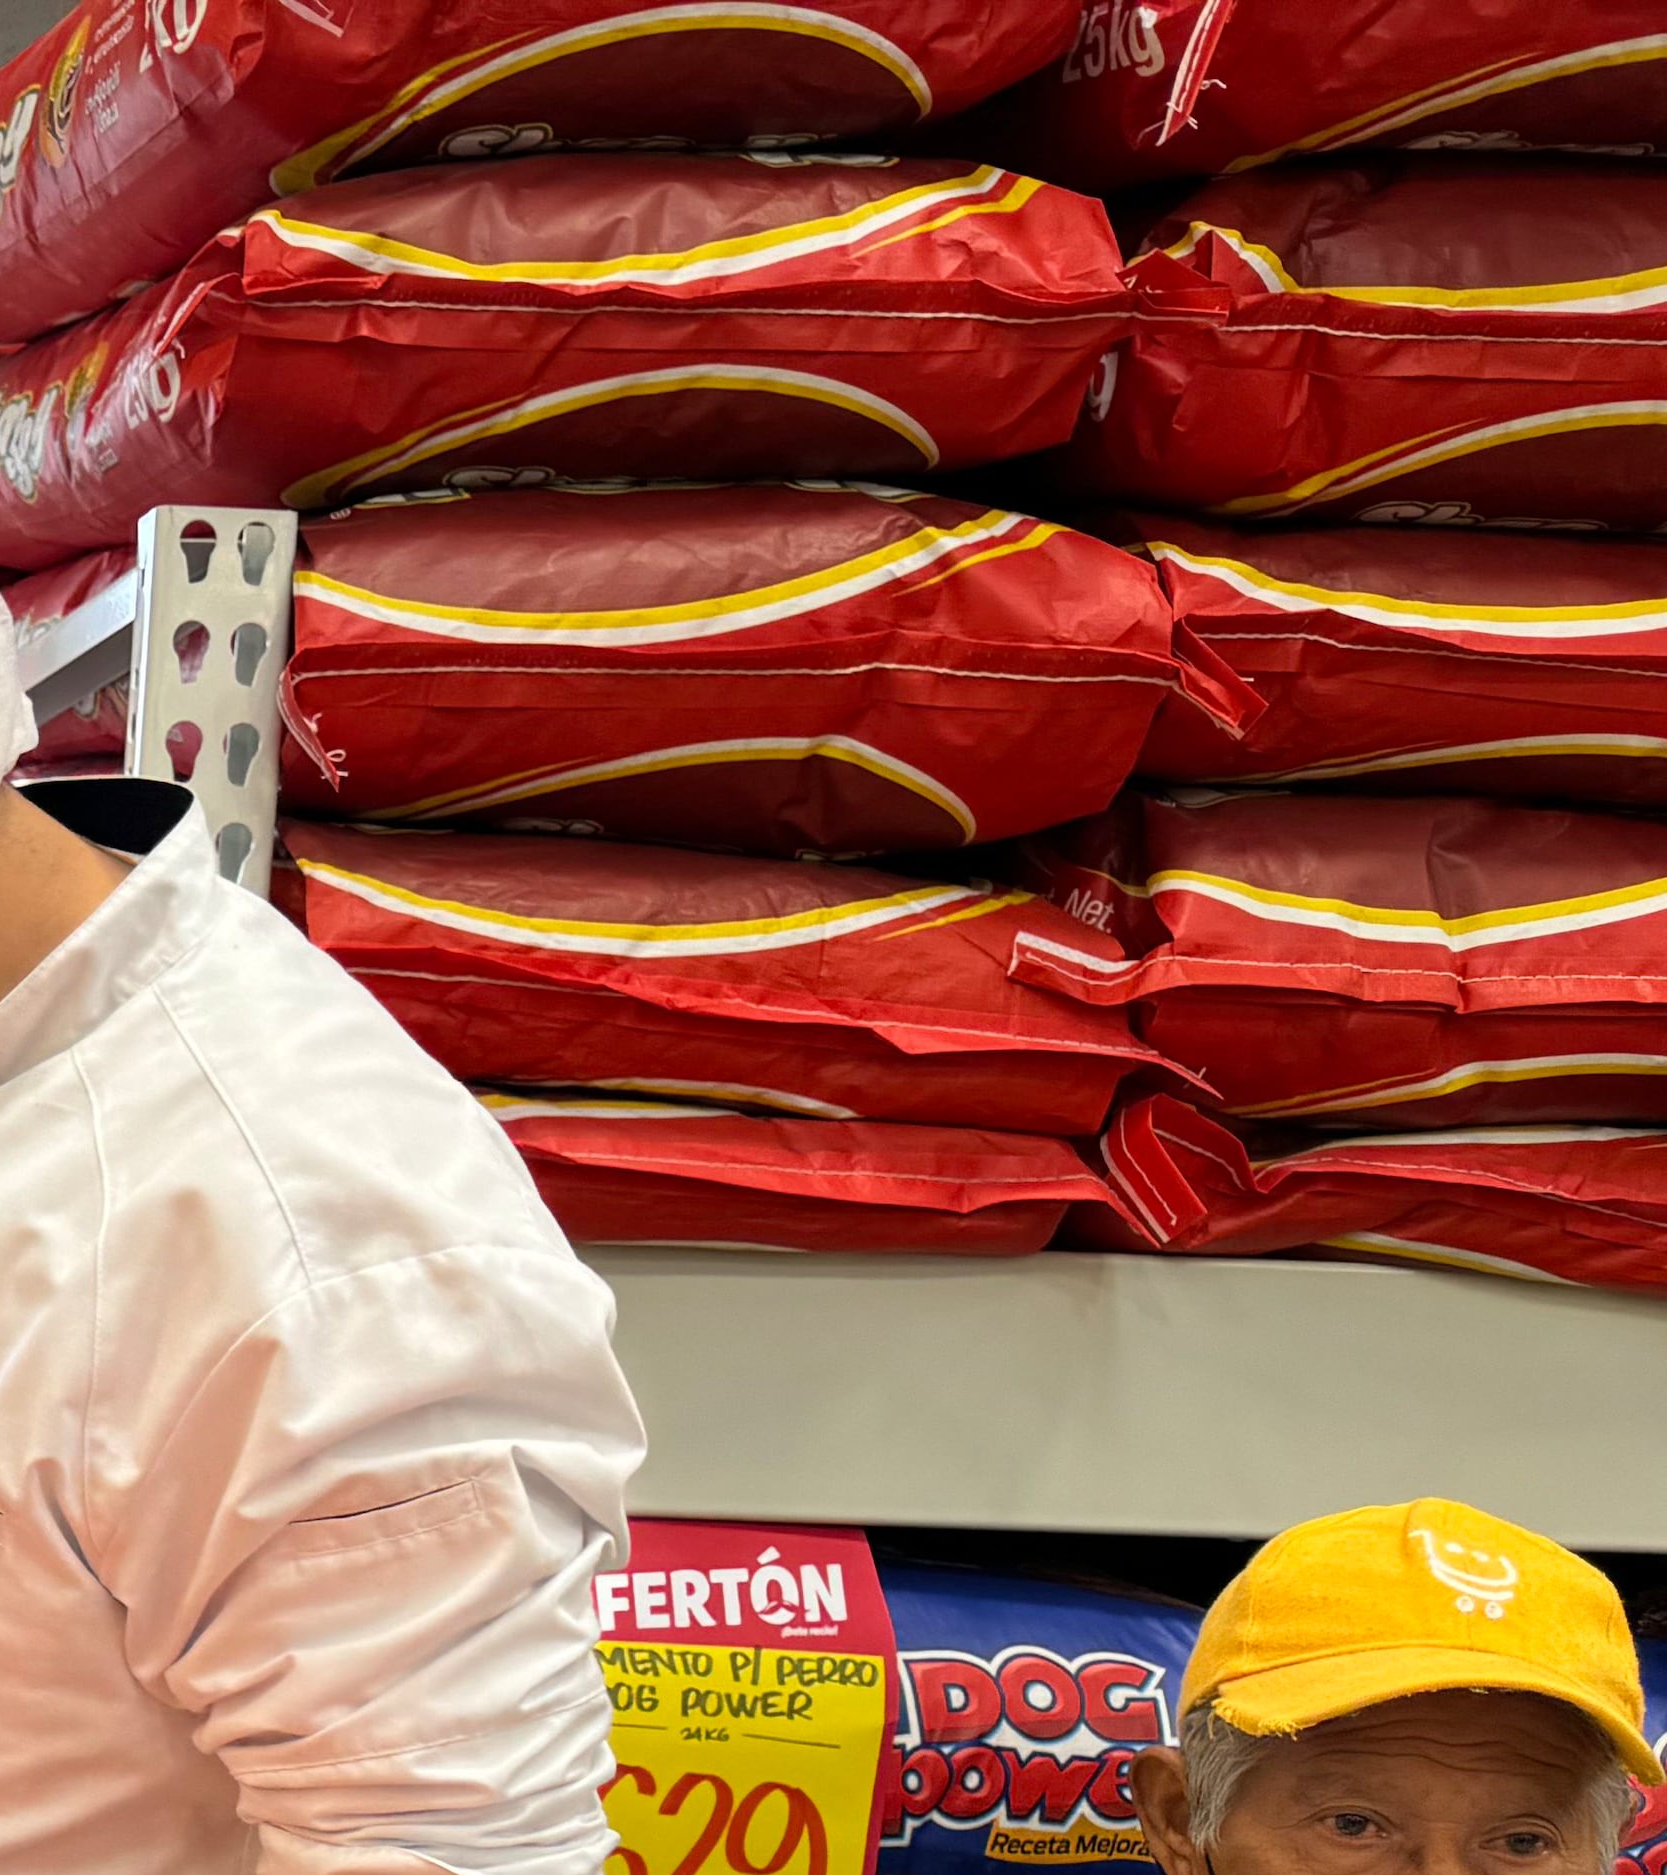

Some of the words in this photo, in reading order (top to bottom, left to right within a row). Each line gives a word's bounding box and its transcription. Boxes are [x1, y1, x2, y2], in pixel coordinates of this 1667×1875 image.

[1062, 0, 1165, 83] 25kg
[1064, 888, 1116, 934] Net.
[730, 1644, 763, 1686] P/
[776, 1656, 880, 1688] PERRO
[607, 1684, 660, 1713] OG
[680, 1686, 814, 1721] POWER
[905, 1654, 1162, 1745] DOG
[990, 1833, 1070, 1856] Receta
